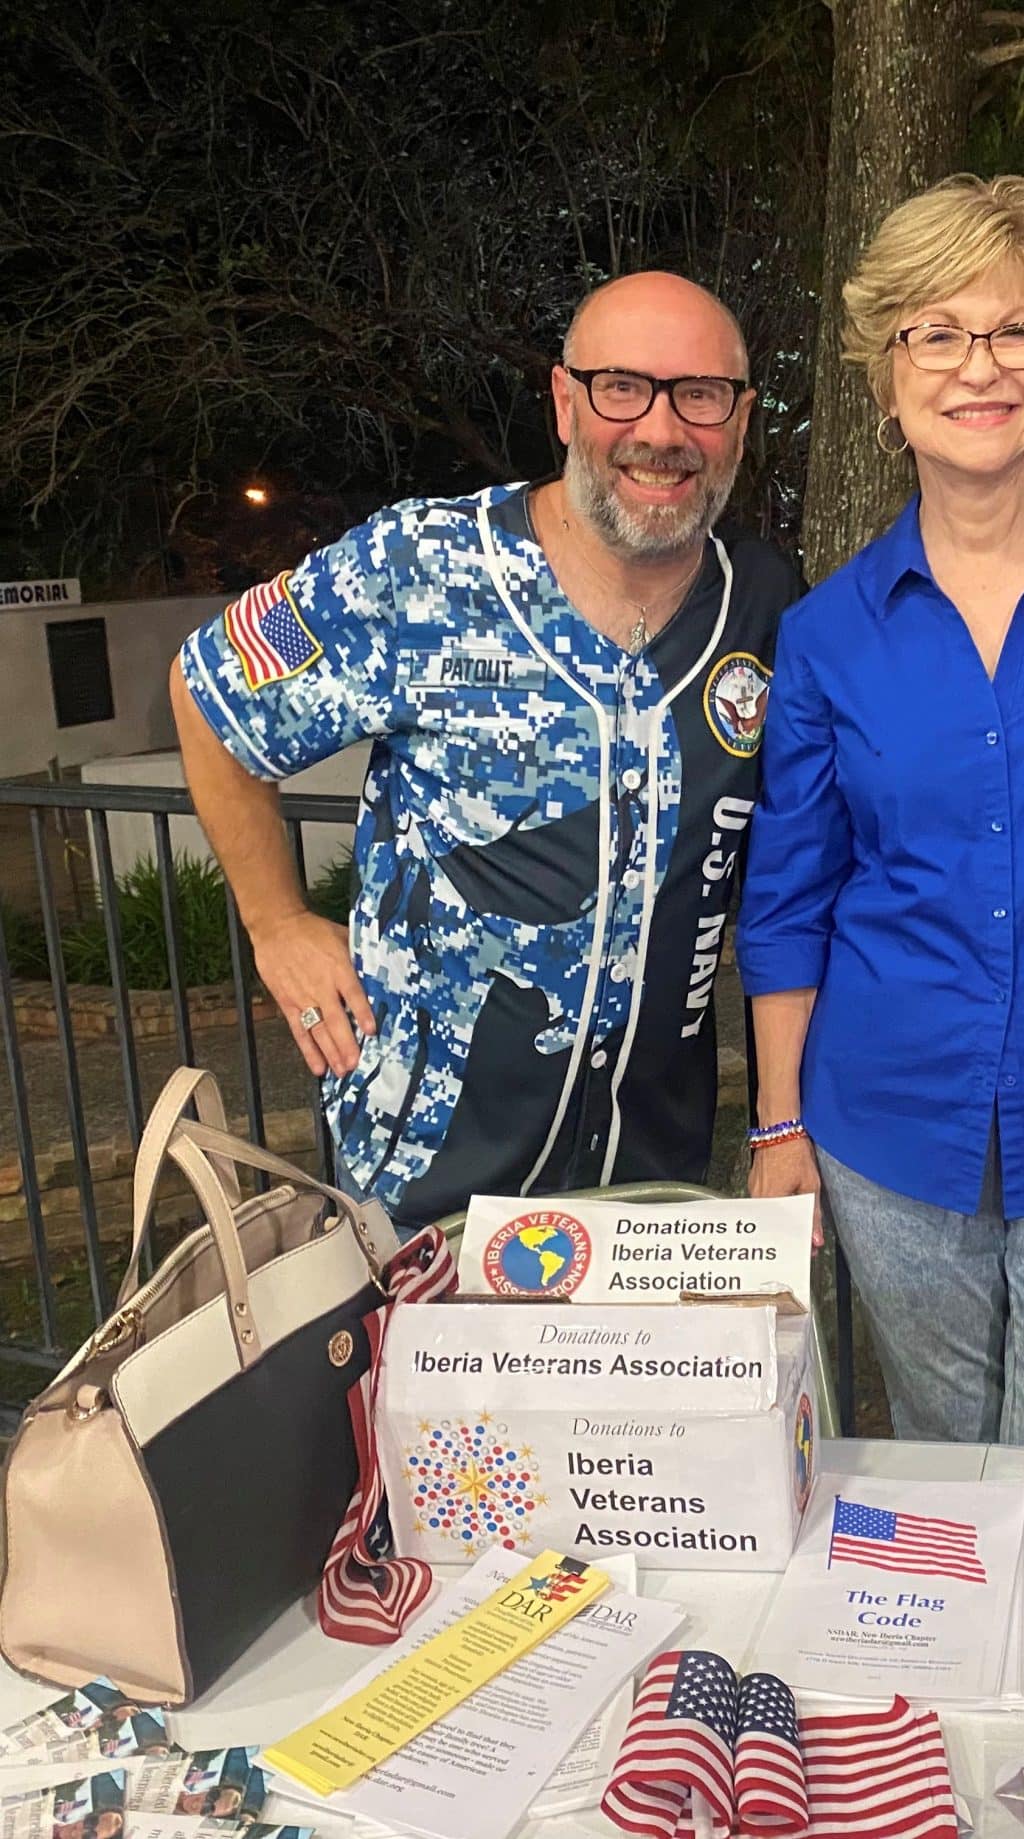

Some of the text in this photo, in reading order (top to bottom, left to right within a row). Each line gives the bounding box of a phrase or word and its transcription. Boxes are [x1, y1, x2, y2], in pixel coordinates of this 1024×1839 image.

[441, 658, 513, 683] PATOUT
[702, 796, 755, 897] U.S.
[681, 913, 727, 1039] NAVY
[487, 1213, 587, 1265] IBERIA VETERANS
[616, 1218, 757, 1236] Donations to
[611, 1243, 778, 1262] Iberia Veterans
[608, 1271, 742, 1291] Association
[538, 1323, 652, 1346] Donations to
[415, 1350, 764, 1379] Iberia Veterans Association
[571, 1416, 686, 1439] Donations to
[567, 1451, 654, 1476] Iberia
[570, 1487, 706, 1515] Veterans
[573, 1522, 758, 1553] Association
[497, 1590, 553, 1623] DAR
[846, 1590, 946, 1613] The Flag
[591, 1603, 638, 1628] DAR
[857, 1611, 922, 1629] Code
